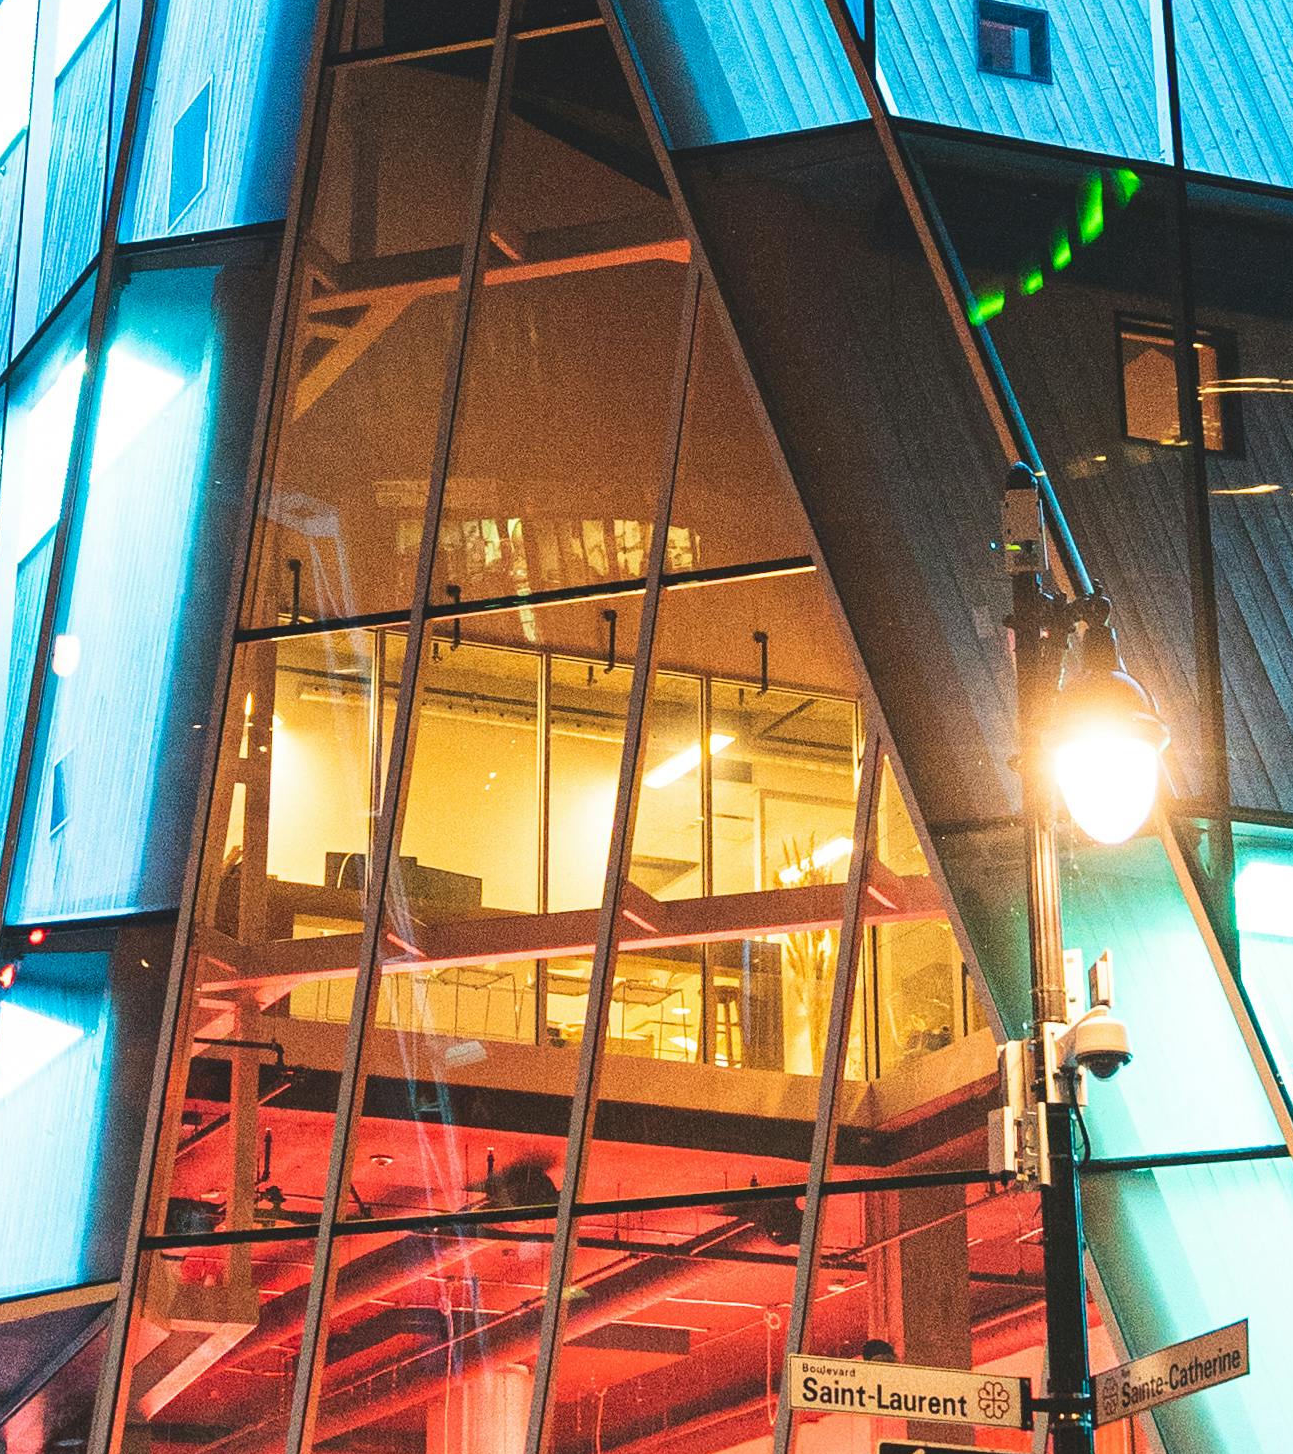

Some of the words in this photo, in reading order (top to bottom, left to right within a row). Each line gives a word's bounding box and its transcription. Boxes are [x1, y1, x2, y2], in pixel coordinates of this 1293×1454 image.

[802, 1363, 857, 1378] Boulevard
[1121, 1347, 1241, 1408] Sainte-Catherine
[802, 1376, 968, 1417] Saint-Laurent
